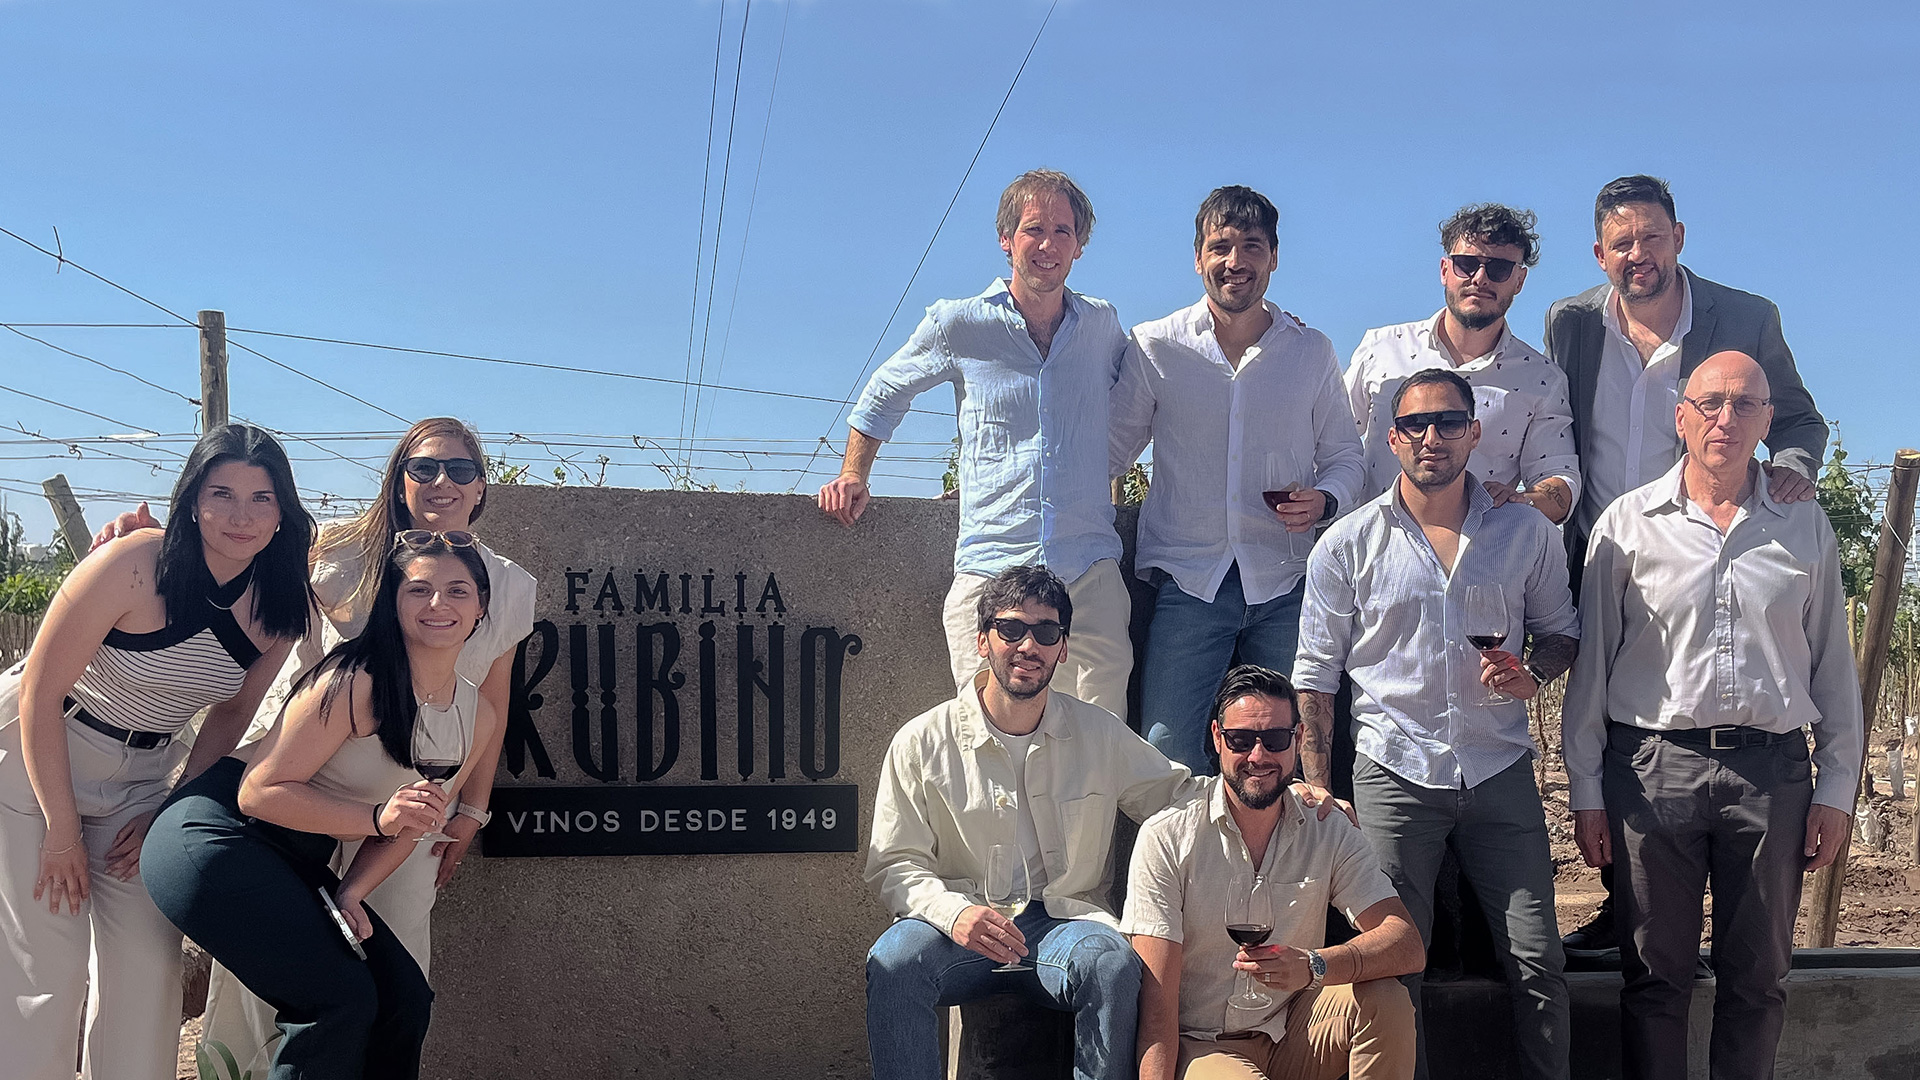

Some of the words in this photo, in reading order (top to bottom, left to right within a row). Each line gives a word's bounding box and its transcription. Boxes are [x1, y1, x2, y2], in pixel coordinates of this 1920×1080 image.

[564, 570, 787, 614] FAMILIA
[507, 810, 621, 834] VINOS
[639, 809, 748, 832] DESDE
[766, 807, 838, 831] 1949
